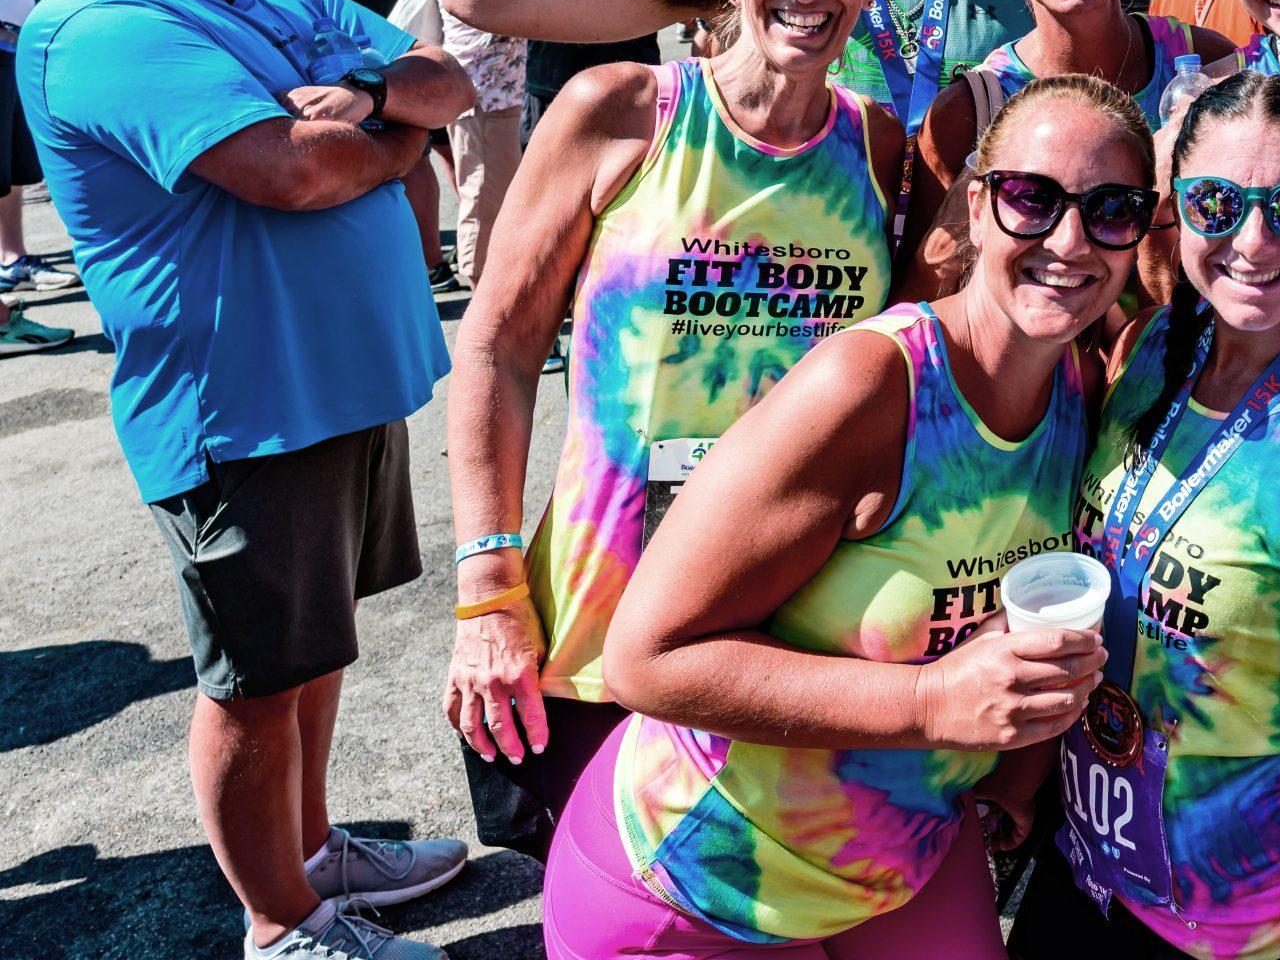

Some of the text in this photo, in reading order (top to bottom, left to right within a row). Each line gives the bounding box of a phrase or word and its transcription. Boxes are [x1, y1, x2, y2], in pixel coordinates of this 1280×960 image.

[877, 30, 897, 61] 15K
[681, 237, 850, 260] Whitesboro
[666, 259, 868, 291] FIT BODY
[663, 290, 865, 319] BOOTCAMP
[1156, 408, 1253, 522] Boilermaker
[946, 530, 1073, 579] Whitesbor
[1104, 525, 1124, 571] 15K
[930, 577, 1001, 622] FIT
